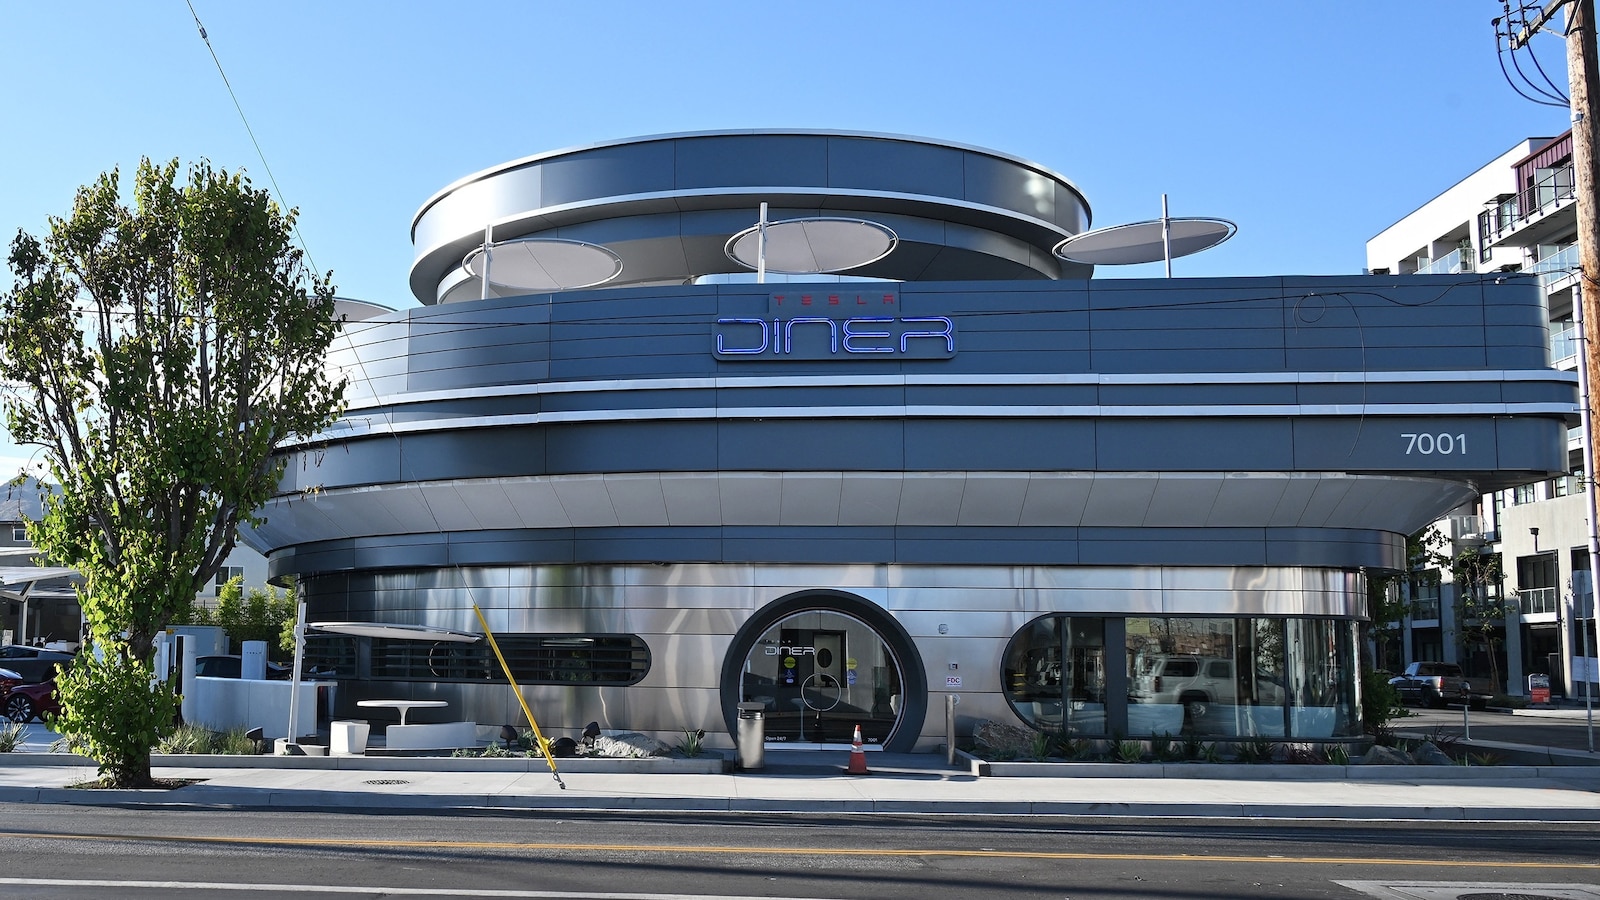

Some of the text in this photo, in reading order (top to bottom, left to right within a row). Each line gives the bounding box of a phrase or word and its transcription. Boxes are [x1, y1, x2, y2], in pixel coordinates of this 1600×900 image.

[774, 295, 895, 306] TESLA
[717, 316, 954, 354] DINER
[1400, 432, 1466, 455] 7001
[765, 646, 815, 655] DINER
